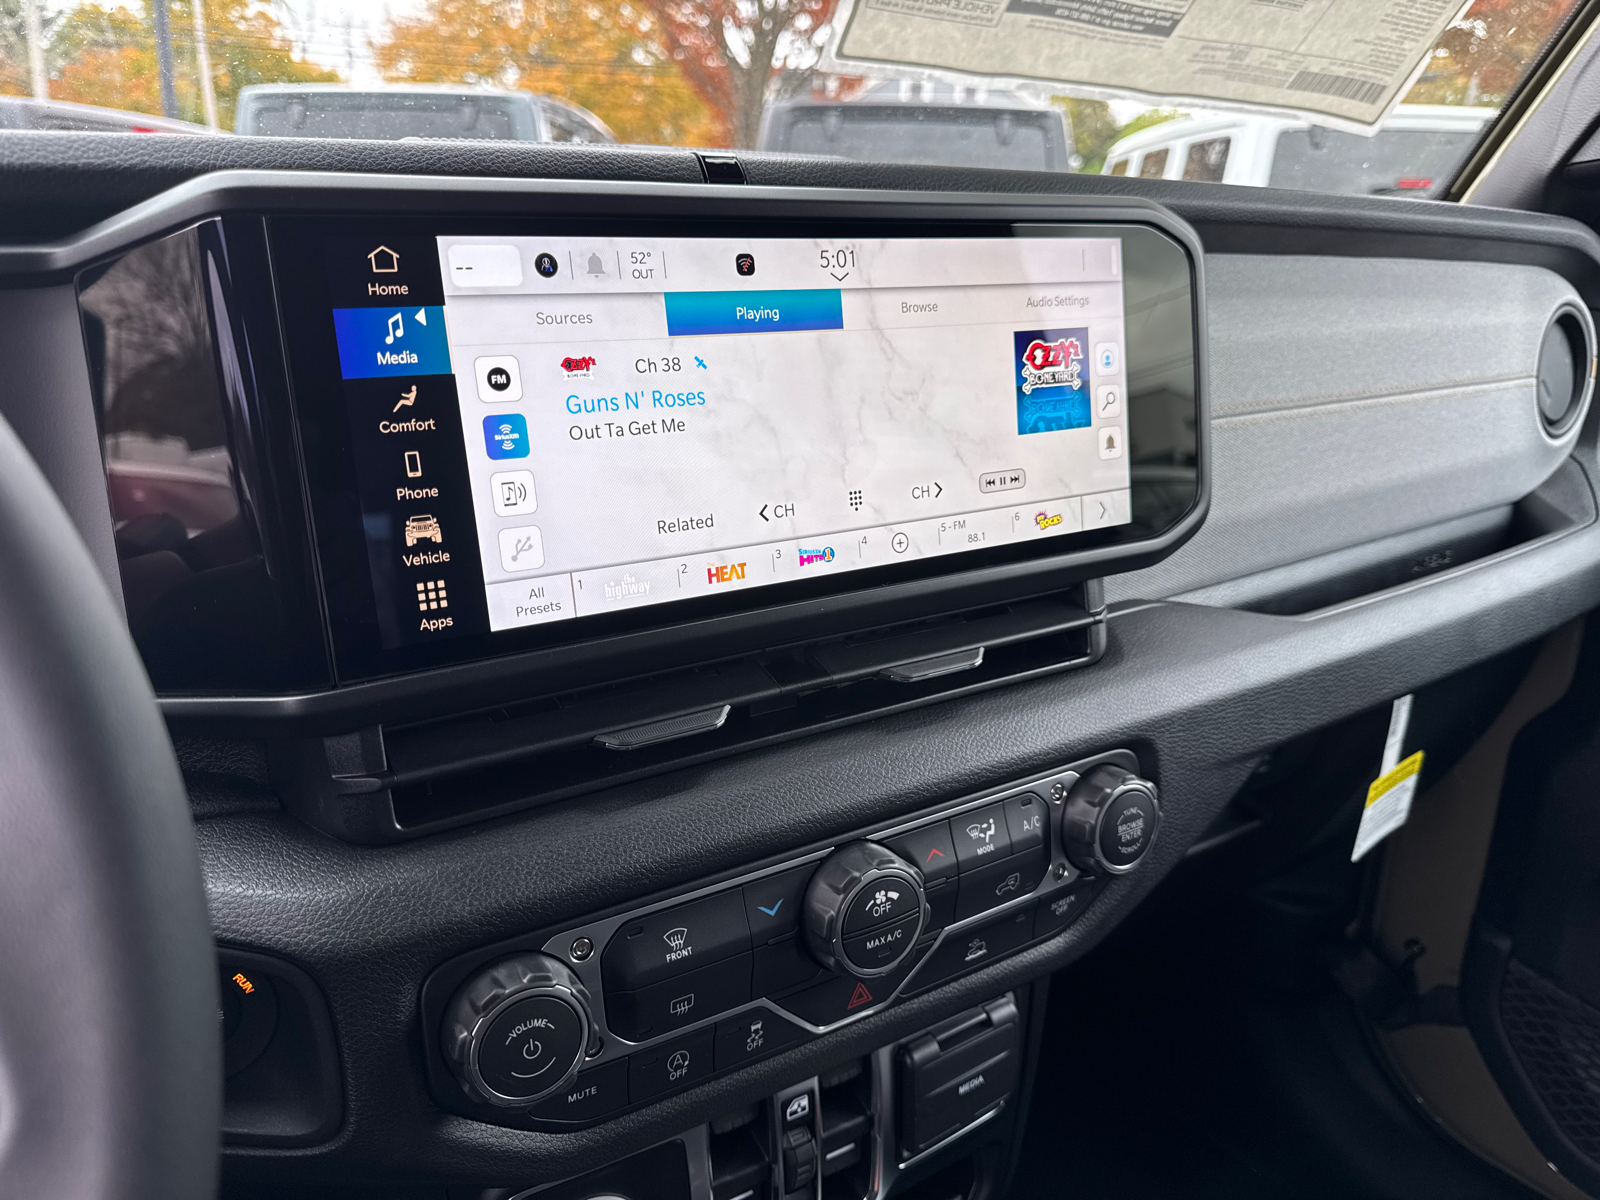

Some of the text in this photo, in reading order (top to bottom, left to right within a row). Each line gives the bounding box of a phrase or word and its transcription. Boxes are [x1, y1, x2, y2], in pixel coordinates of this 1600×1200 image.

[630, 251, 652, 265] 52°
[819, 248, 857, 269] 5:01
[631, 268, 654, 280] OUT
[367, 282, 409, 296] Home
[901, 301, 938, 314] Browse
[1025, 295, 1090, 308] Audio Settings
[535, 311, 593, 326] Sources
[735, 305, 780, 322] Playing
[376, 350, 418, 366] Media
[635, 356, 682, 373] Ch 38
[490, 374, 507, 385] FM
[1028, 370, 1076, 385] BONEYARD
[566, 389, 706, 414] Guns N' Roses
[379, 418, 436, 433] Comfort
[569, 418, 686, 441] Out Ta Get Me
[396, 486, 439, 501] Phone
[912, 485, 931, 500] CH
[773, 503, 796, 519] CH
[1014, 511, 1020, 521] 6
[657, 513, 714, 534] Related
[861, 535, 868, 545] 4
[967, 532, 986, 543] 88.1
[402, 550, 451, 567] Vehicle
[775, 549, 782, 559] 3
[680, 563, 688, 574] 2
[706, 562, 748, 585] HEAT
[577, 579, 583, 590] 1
[604, 580, 651, 600] highway
[528, 586, 545, 600] All
[515, 601, 562, 618] Presets
[419, 616, 454, 632] Apps
[1022, 815, 1042, 832] A/C
[1117, 817, 1144, 834] BROWSE
[1121, 828, 1142, 842] ENTER
[976, 843, 995, 856] MODE
[872, 901, 893, 918] OFF
[866, 928, 903, 950] MAX A/C
[665, 946, 693, 963] FRONT
[232, 972, 255, 994] RUN
[510, 1018, 549, 1039] VOLUME
[746, 1037, 764, 1052] OFF
[669, 1067, 688, 1081] OFF
[958, 1074, 985, 1097] MEDIA
[567, 1085, 598, 1104] MUTE
